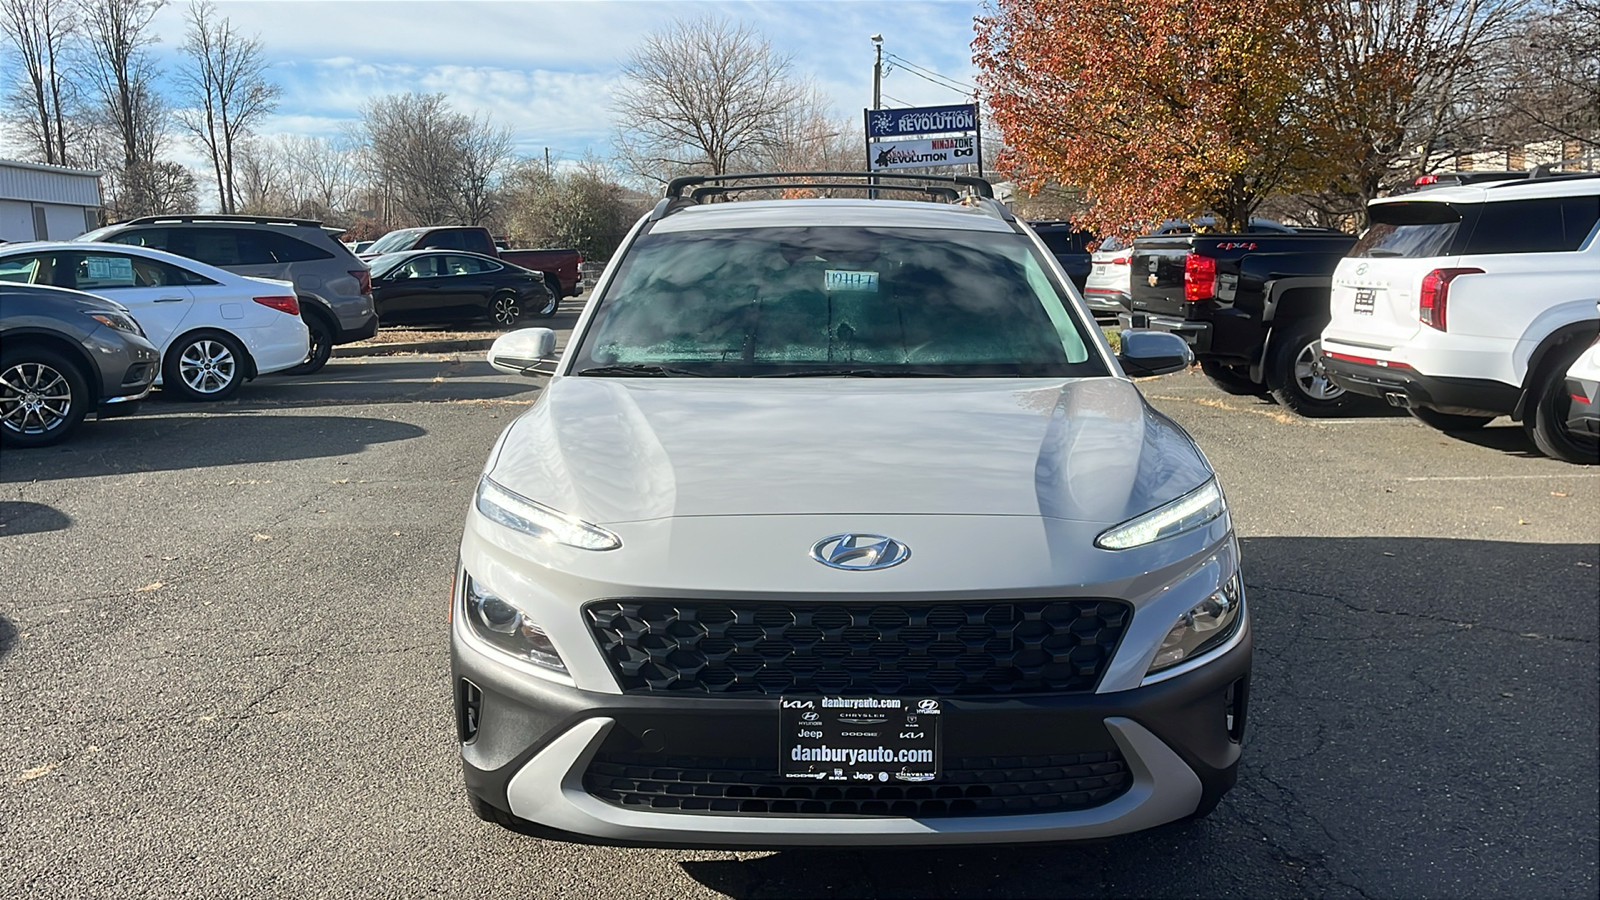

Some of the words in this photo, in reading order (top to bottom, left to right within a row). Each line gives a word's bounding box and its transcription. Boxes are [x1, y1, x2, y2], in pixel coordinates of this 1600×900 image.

[901, 110, 970, 120] GYMNASTICS
[898, 115, 973, 132] REVOLUTION
[887, 153, 947, 165] REVOLUTION
[1336, 279, 1392, 287] PALISADE
[821, 696, 901, 709] danburyauto.com
[797, 728, 823, 739] Jeep
[791, 744, 933, 766] danburyauto.com
[852, 771, 874, 781] Jeep
